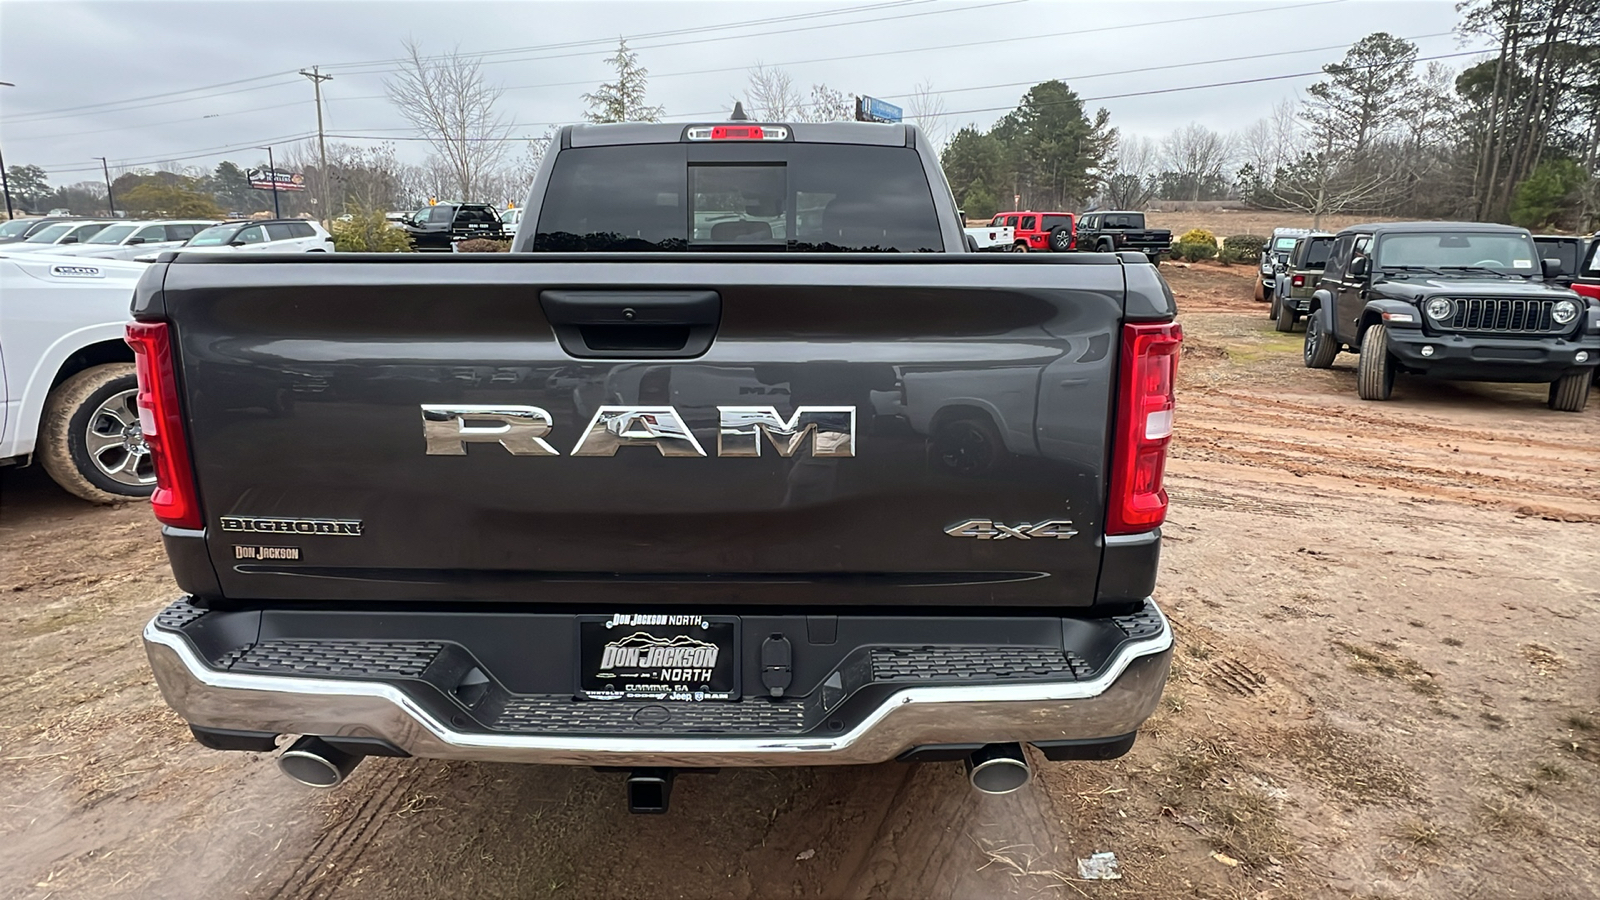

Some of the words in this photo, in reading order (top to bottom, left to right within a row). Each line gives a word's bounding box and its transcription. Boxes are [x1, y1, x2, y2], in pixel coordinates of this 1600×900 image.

[420, 404, 857, 458] RAM
[220, 517, 363, 536] BIGHORN
[235, 545, 255, 560] DON
[256, 546, 299, 560] JACKSON
[612, 613, 631, 626] DON
[630, 613, 668, 626] JACKSON
[668, 615, 702, 626] NORTH
[600, 646, 640, 670] DON
[639, 646, 720, 669] JACKSON
[661, 669, 712, 682] NORTH
[674, 684, 689, 692] GA
[669, 691, 693, 702] Jeep
